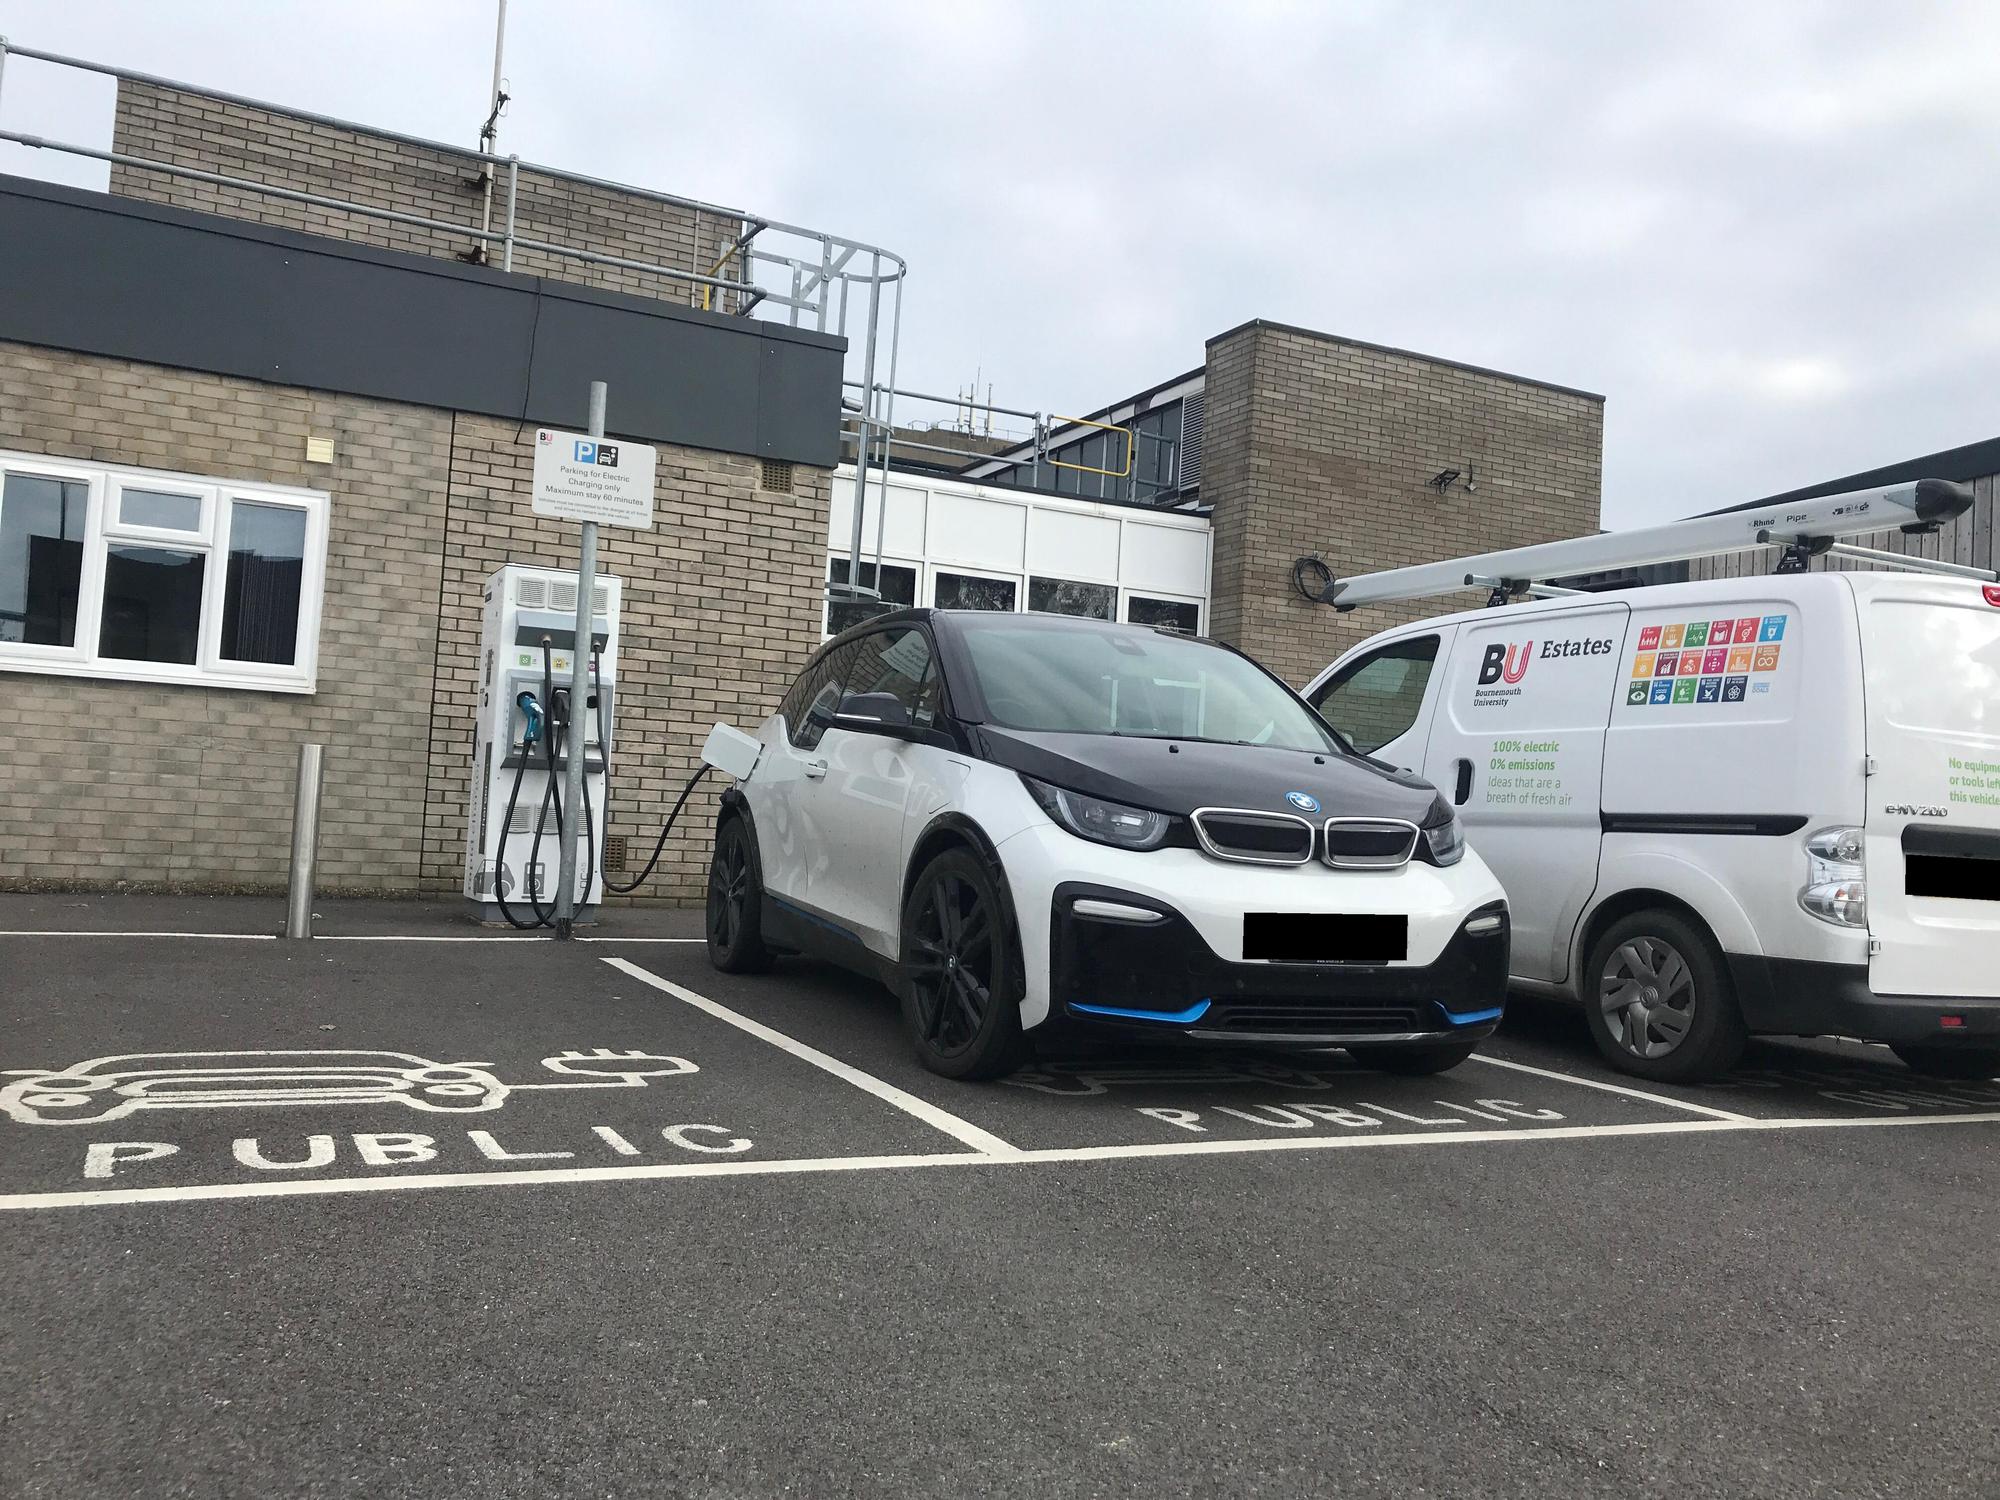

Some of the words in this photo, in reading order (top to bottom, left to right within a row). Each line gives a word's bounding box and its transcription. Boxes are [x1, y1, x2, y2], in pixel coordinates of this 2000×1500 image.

[560, 465, 588, 477] Parking
[590, 469, 600, 478] for
[603, 472, 630, 483] Electric
[568, 478, 602, 490] Charging
[605, 483, 621, 492] only
[545, 485, 584, 497] Maximum
[586, 490, 601, 500] stay
[614, 496, 644, 506] minutes
[1753, 519, 1775, 527] Rhino
[1786, 514, 1807, 523] Pipe
[1540, 638, 1613, 659] Estates
[1478, 640, 1533, 685] BU
[1475, 688, 1521, 697] Bournemouth
[1473, 698, 1508, 707] University
[1493, 741, 1521, 752] 100%
[1524, 741, 1560, 752] electric
[1490, 758, 1506, 770] 0%
[1508, 758, 1555, 770] emissions
[1949, 757, 1962, 769] No
[1488, 776, 1512, 788] Ideas
[1515, 776, 1534, 788] that
[1536, 779, 1552, 789] are
[1555, 779, 1561, 789] a
[1949, 776, 1959, 785] or
[1962, 775, 1984, 788] tools
[1486, 791, 1516, 803] breath
[1519, 792, 1530, 804] of
[1531, 792, 1556, 805] fresh
[1559, 793, 1573, 806] air
[1950, 790, 1967, 802] this
[1133, 1099, 1567, 1132] PUBLIC
[83, 1124, 753, 1178] PUBLIC
